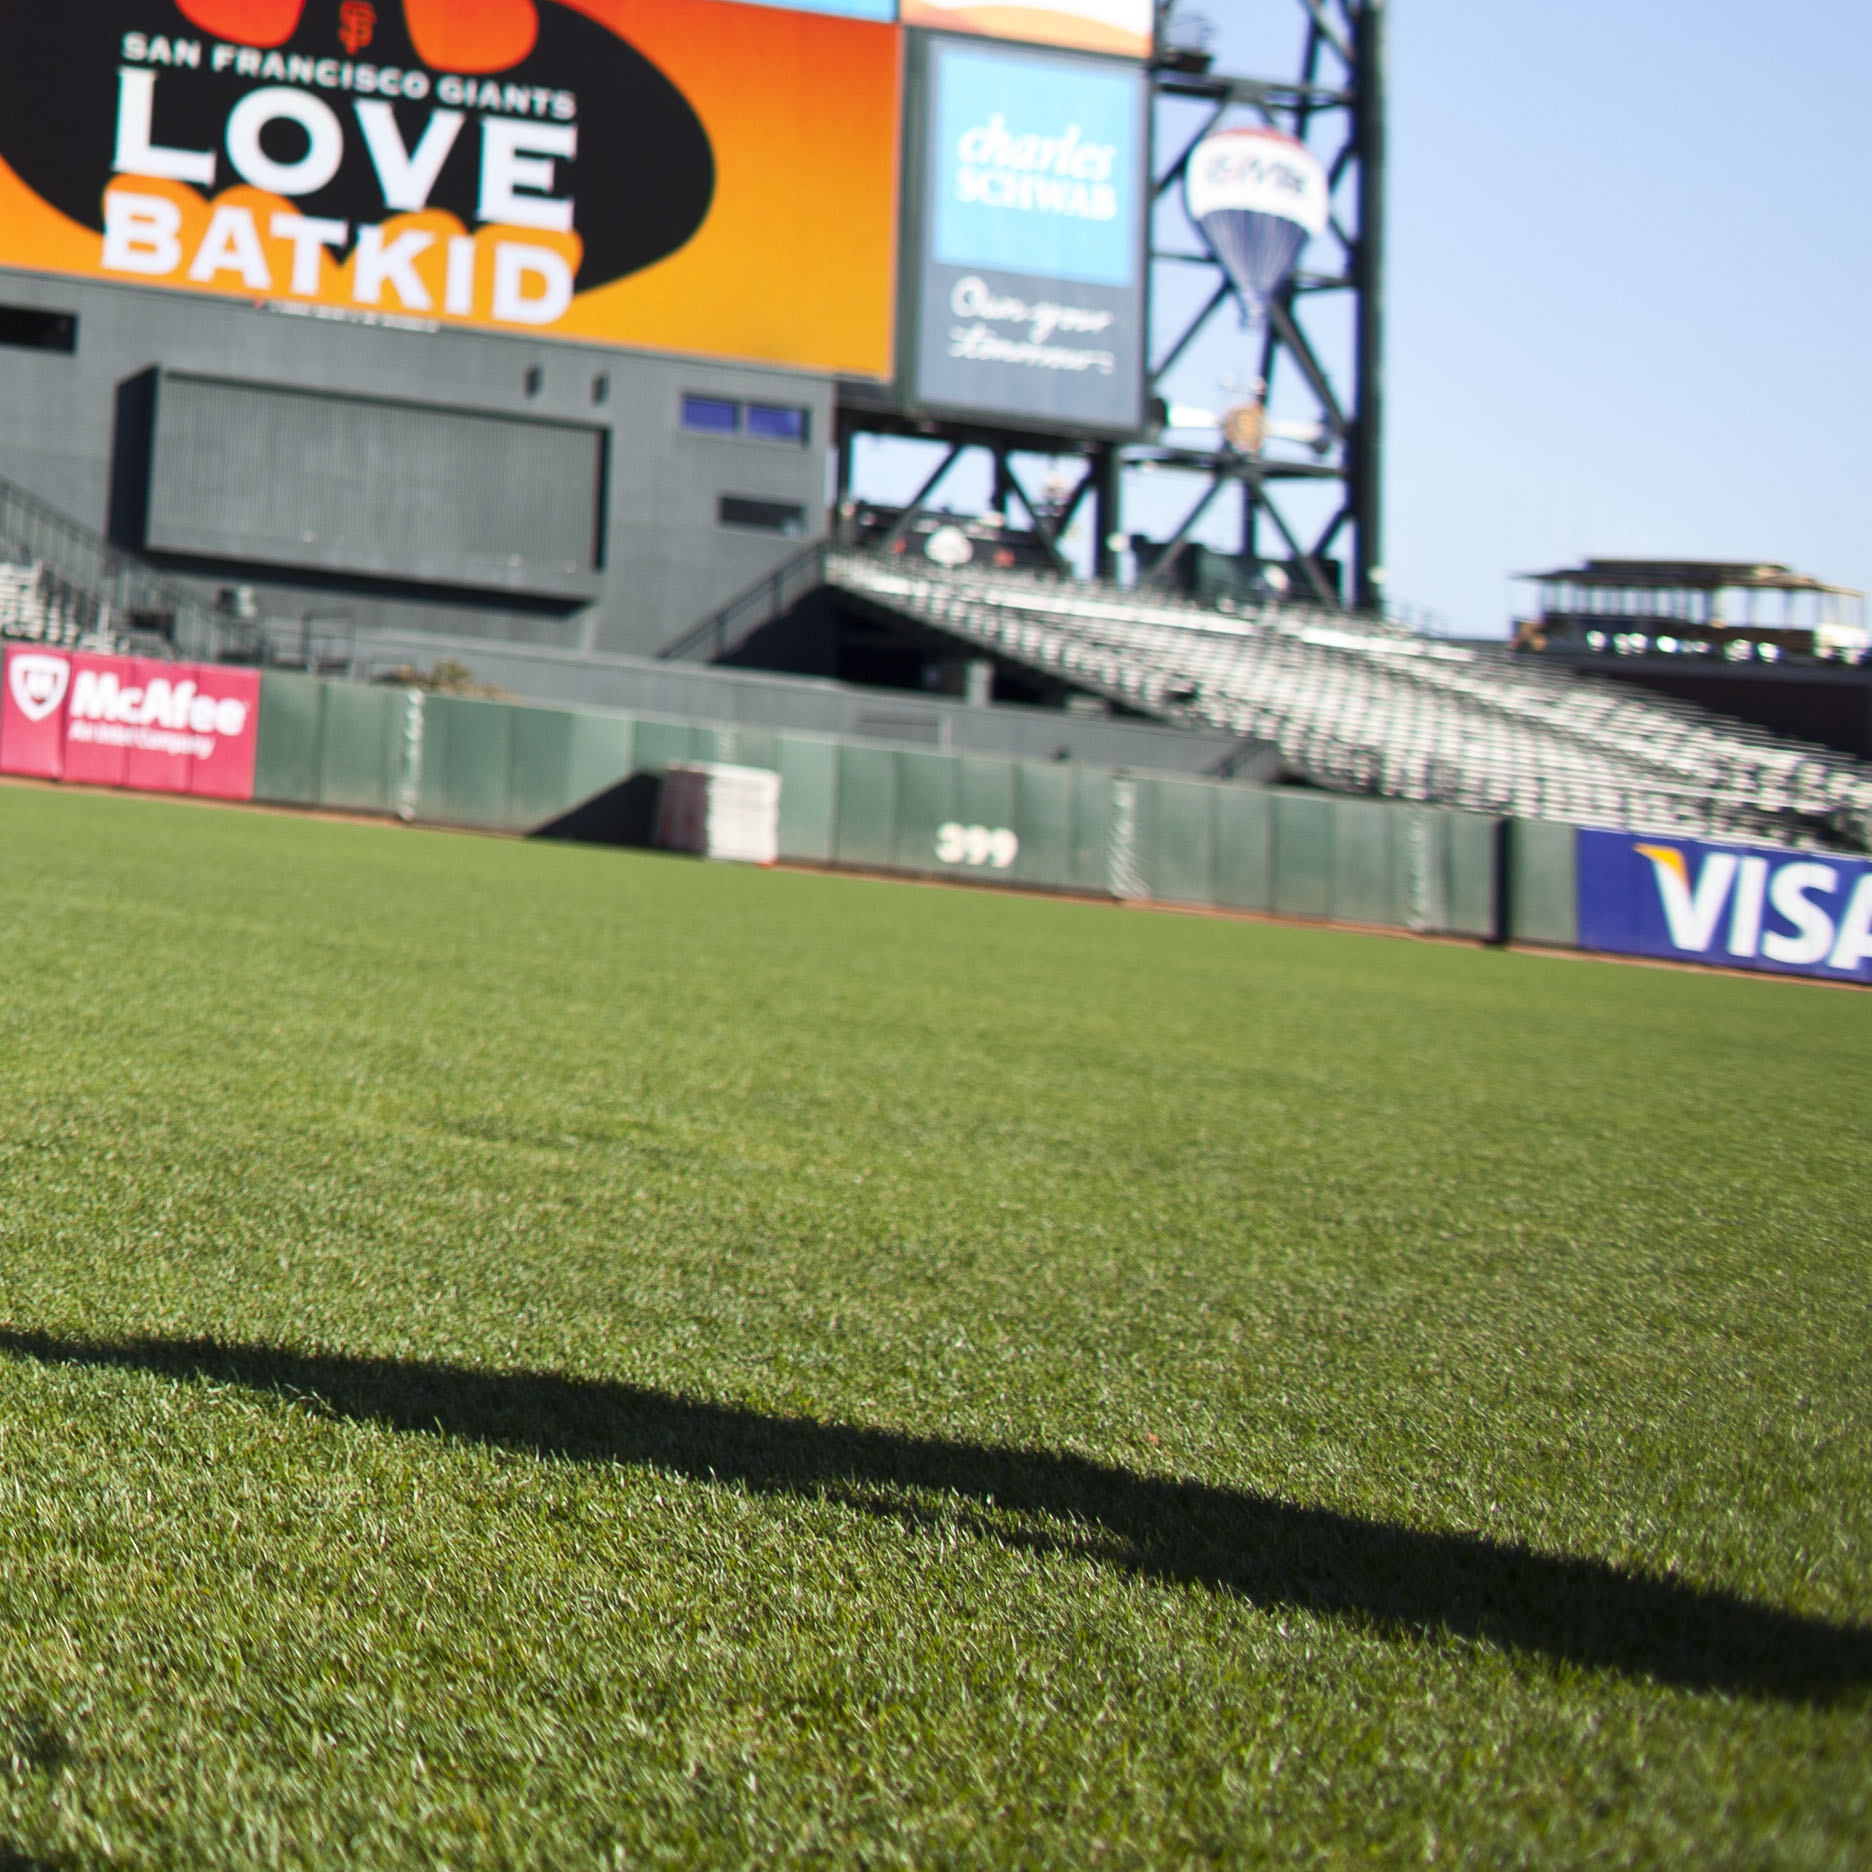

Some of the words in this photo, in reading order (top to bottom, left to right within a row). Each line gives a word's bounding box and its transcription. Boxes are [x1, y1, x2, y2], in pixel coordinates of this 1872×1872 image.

[122, 32, 201, 69] SAN
[212, 44, 430, 100] FRANCISCO
[437, 75, 577, 120] GIANTS
[113, 65, 578, 233] LOVE
[958, 112, 1116, 181] charles
[956, 166, 1117, 221] SCHWAB
[101, 189, 574, 325] BATKID
[70, 669, 247, 736] McAfee
[935, 821, 1019, 869] 399
